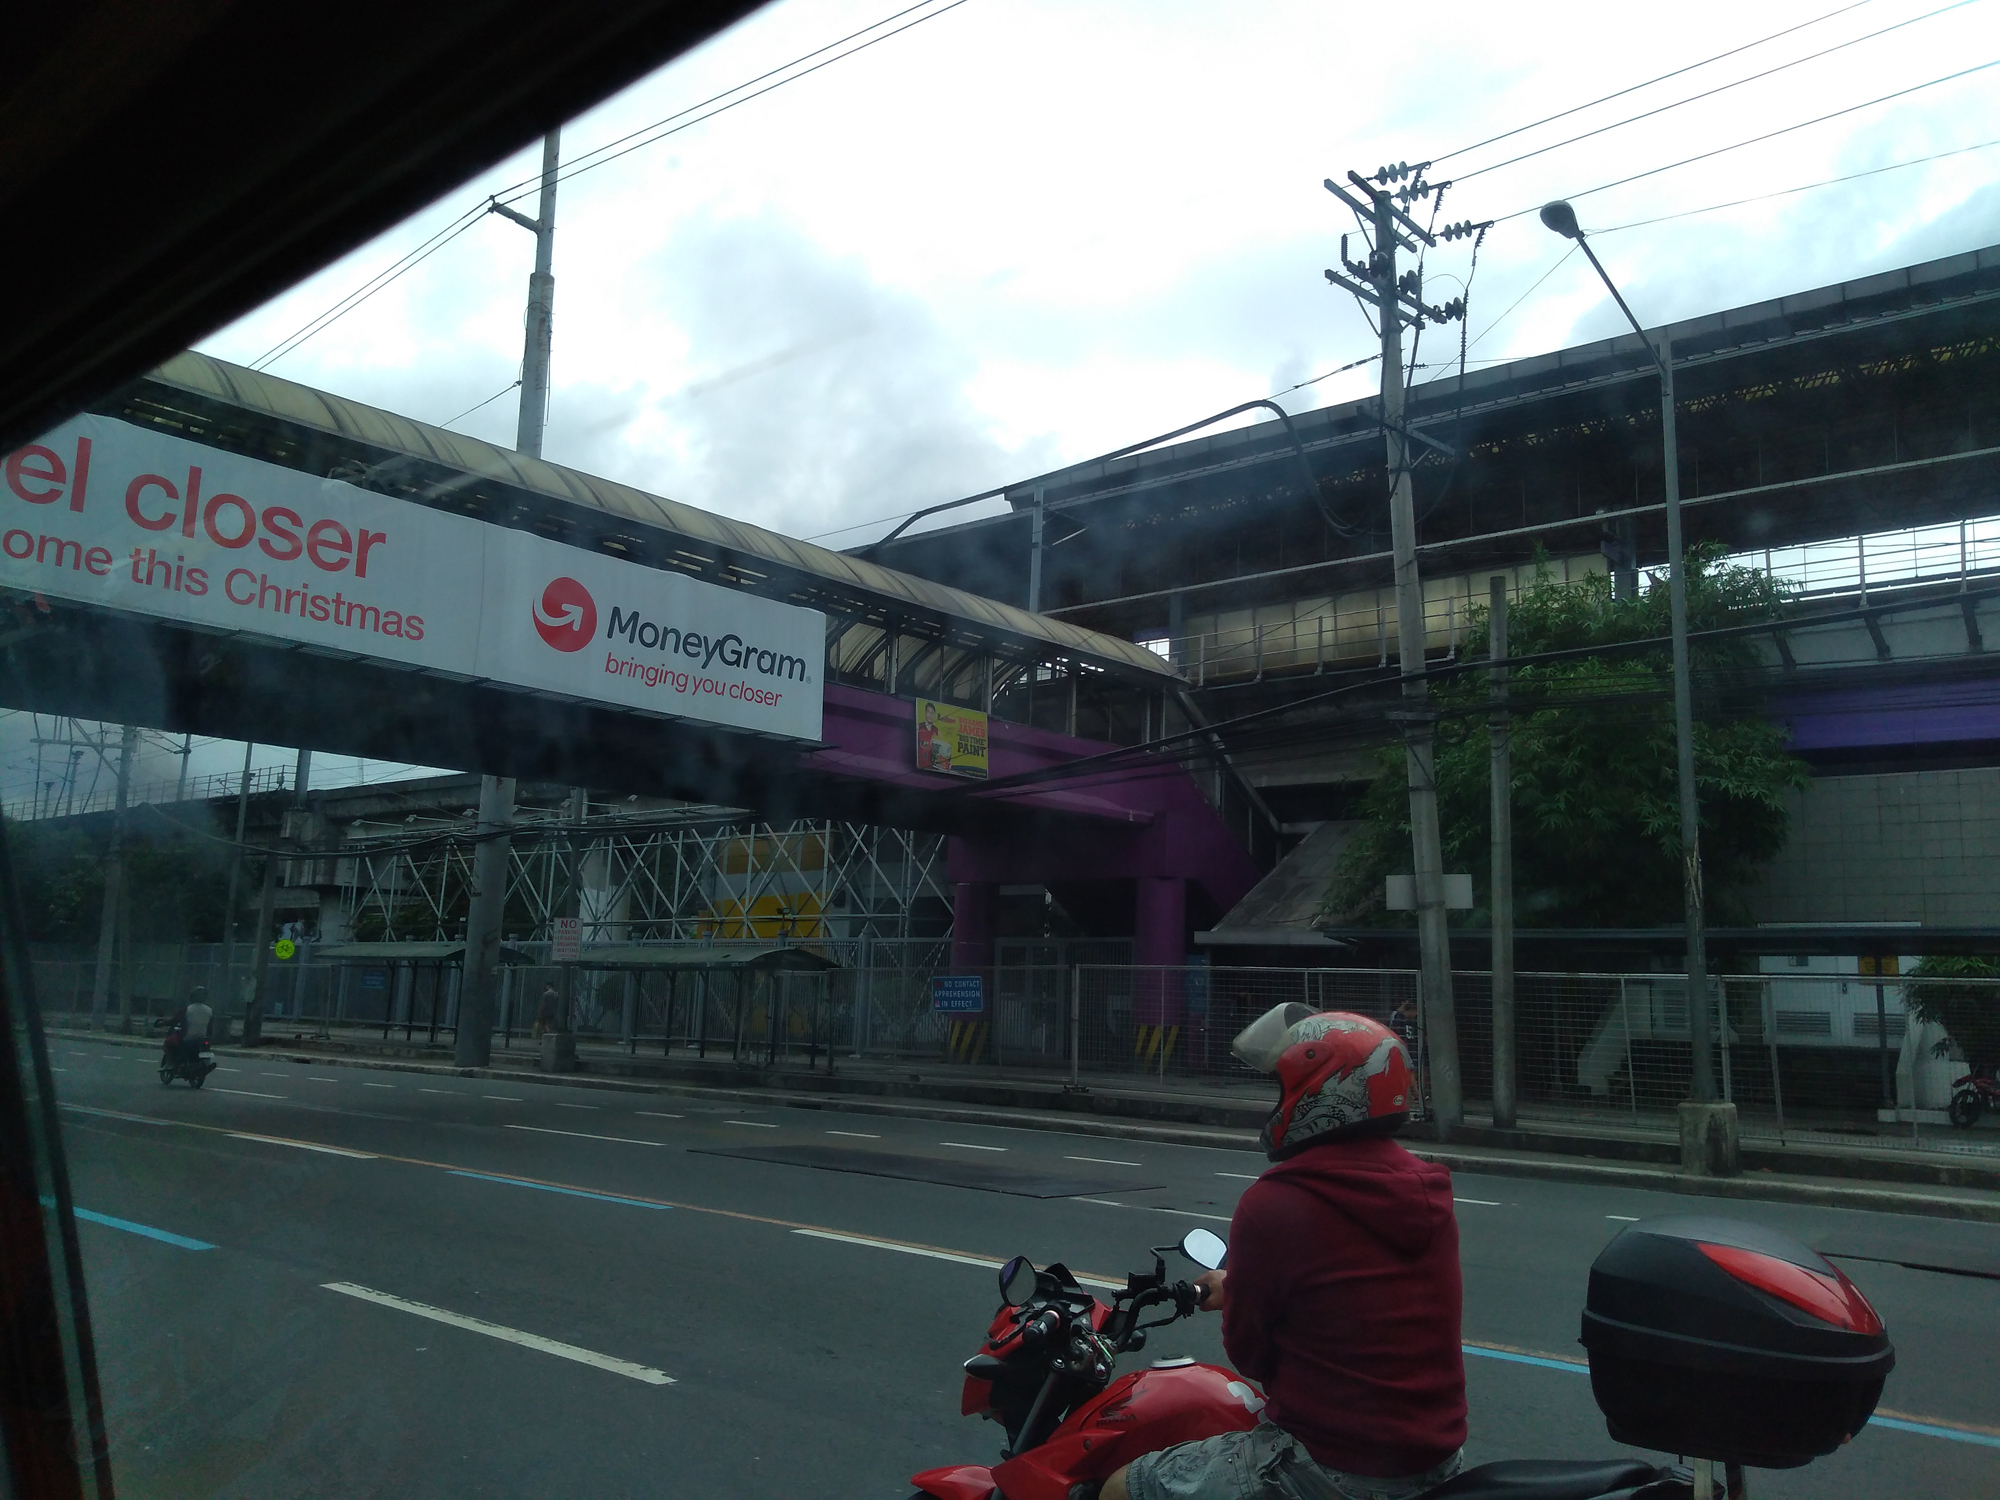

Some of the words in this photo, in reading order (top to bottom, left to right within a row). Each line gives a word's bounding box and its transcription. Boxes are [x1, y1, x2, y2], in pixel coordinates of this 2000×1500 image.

[125, 465, 387, 579] closer
[2, 528, 113, 576] ome
[129, 547, 209, 596] this
[224, 568, 426, 642] Christmas
[606, 605, 807, 683] MoneyGram
[604, 652, 690, 694] bringing
[691, 677, 726, 697] you
[728, 680, 783, 707] closer
[958, 723, 986, 739] JAMES
[958, 741, 986, 757] PAINT
[560, 919, 577, 929] NO
[944, 980, 953, 988] NO
[954, 980, 980, 988] CONTACT
[934, 990, 981, 998] APPREHENSION
[951, 1000, 973, 1008] EFFECT
[1096, 1413, 1138, 1428] HONDA
